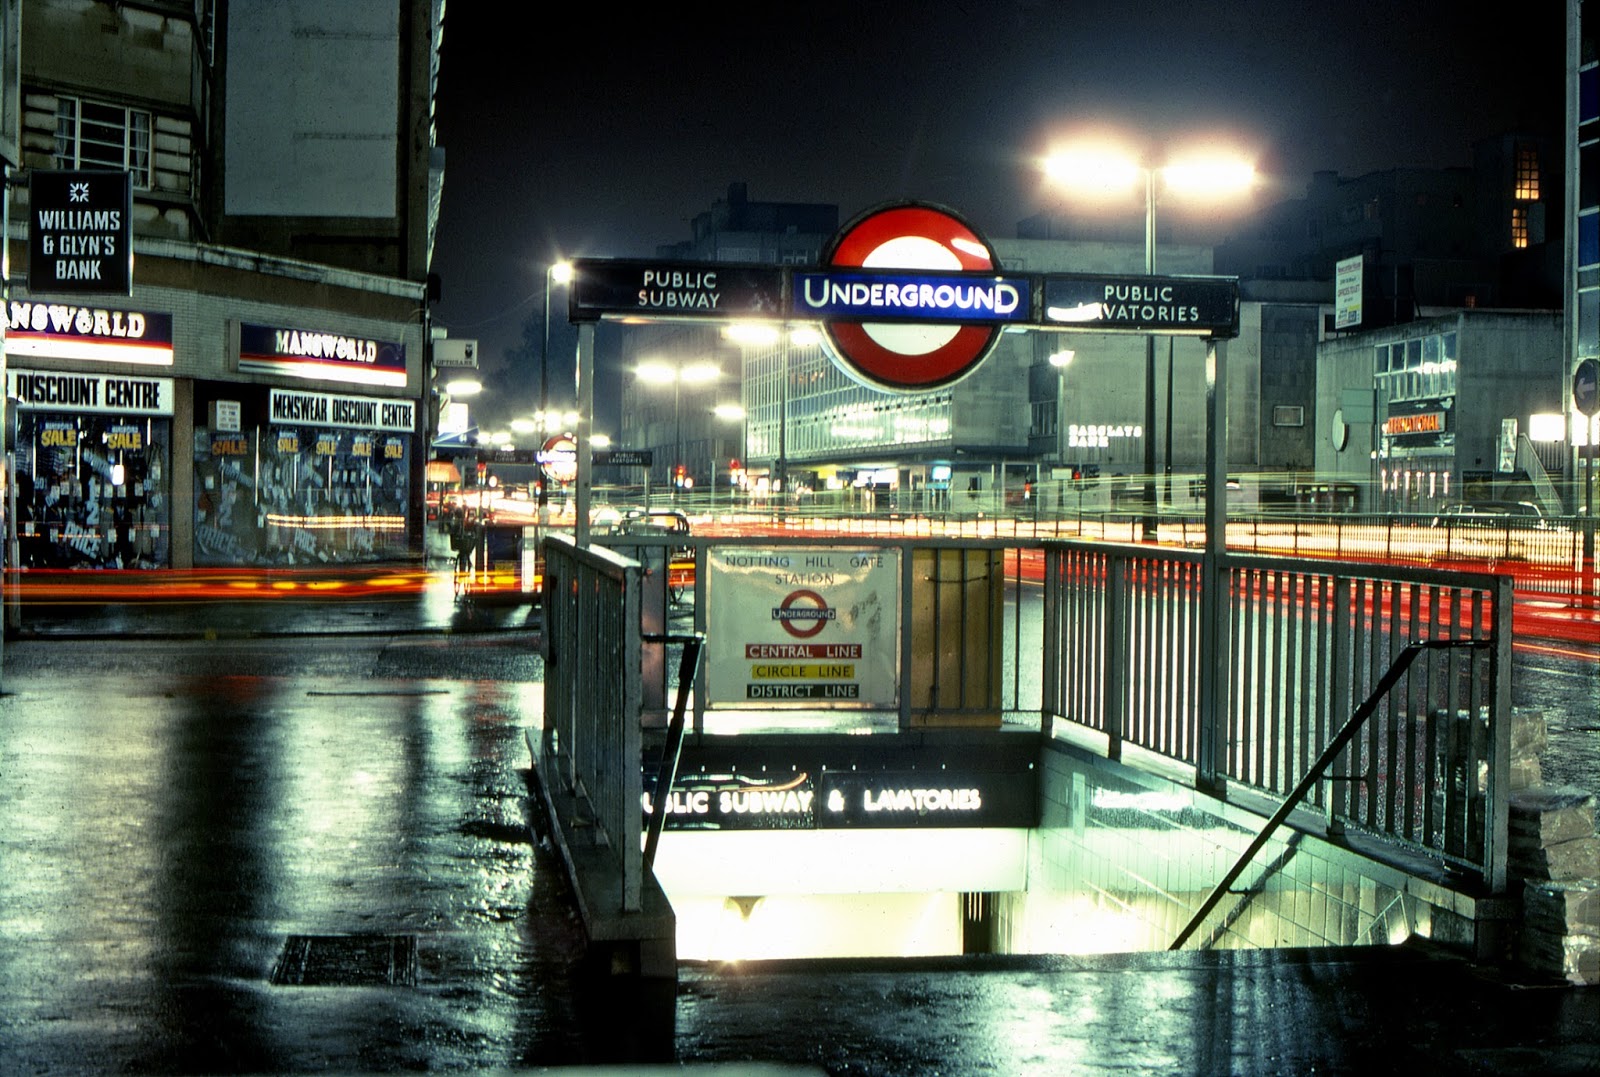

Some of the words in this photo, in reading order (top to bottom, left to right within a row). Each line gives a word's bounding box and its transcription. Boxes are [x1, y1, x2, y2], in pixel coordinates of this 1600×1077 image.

[38, 210, 120, 231] WILLIAMS
[43, 235, 54, 255] &
[59, 235, 115, 256] GLYN'S
[56, 260, 101, 280] BANK
[643, 270, 717, 289] PUBLIC
[638, 289, 720, 308] SUBWAY
[1104, 285, 1173, 301] PUBLIC
[1082, 302, 1199, 322] VATORIES
[275, 330, 377, 363] MANSWORLD
[16, 374, 100, 406] DISCOUNT
[105, 380, 160, 409] CENTRE
[273, 394, 328, 422] MENSWEAR
[332, 399, 378, 425] DISCOUNT
[381, 402, 413, 428] CENTRE
[41, 429, 77, 447] SALE
[1068, 424, 1143, 437] BARCLAYS
[107, 433, 142, 449] SALE
[211, 440, 248, 455] SALE
[277, 439, 299, 453] SALE
[316, 441, 336, 455] SALE
[352, 442, 372, 456] SALE
[385, 445, 403, 459] SALE
[726, 556, 790, 568] NOTTING
[805, 556, 834, 568] HILL
[849, 556, 884, 568] GATE
[775, 573, 835, 585] STATION
[772, 609, 835, 619] UNDERGROUND
[749, 645, 813, 658] CENTRAL
[826, 645, 858, 658] LINE
[756, 665, 807, 677] CIRCLE
[818, 665, 850, 677] LINE
[751, 685, 814, 697] DISTRICT
[824, 685, 856, 697] LINE
[719, 791, 813, 814] SUBWAY
[828, 790, 844, 812] &
[864, 789, 981, 811] LAVATORIES
